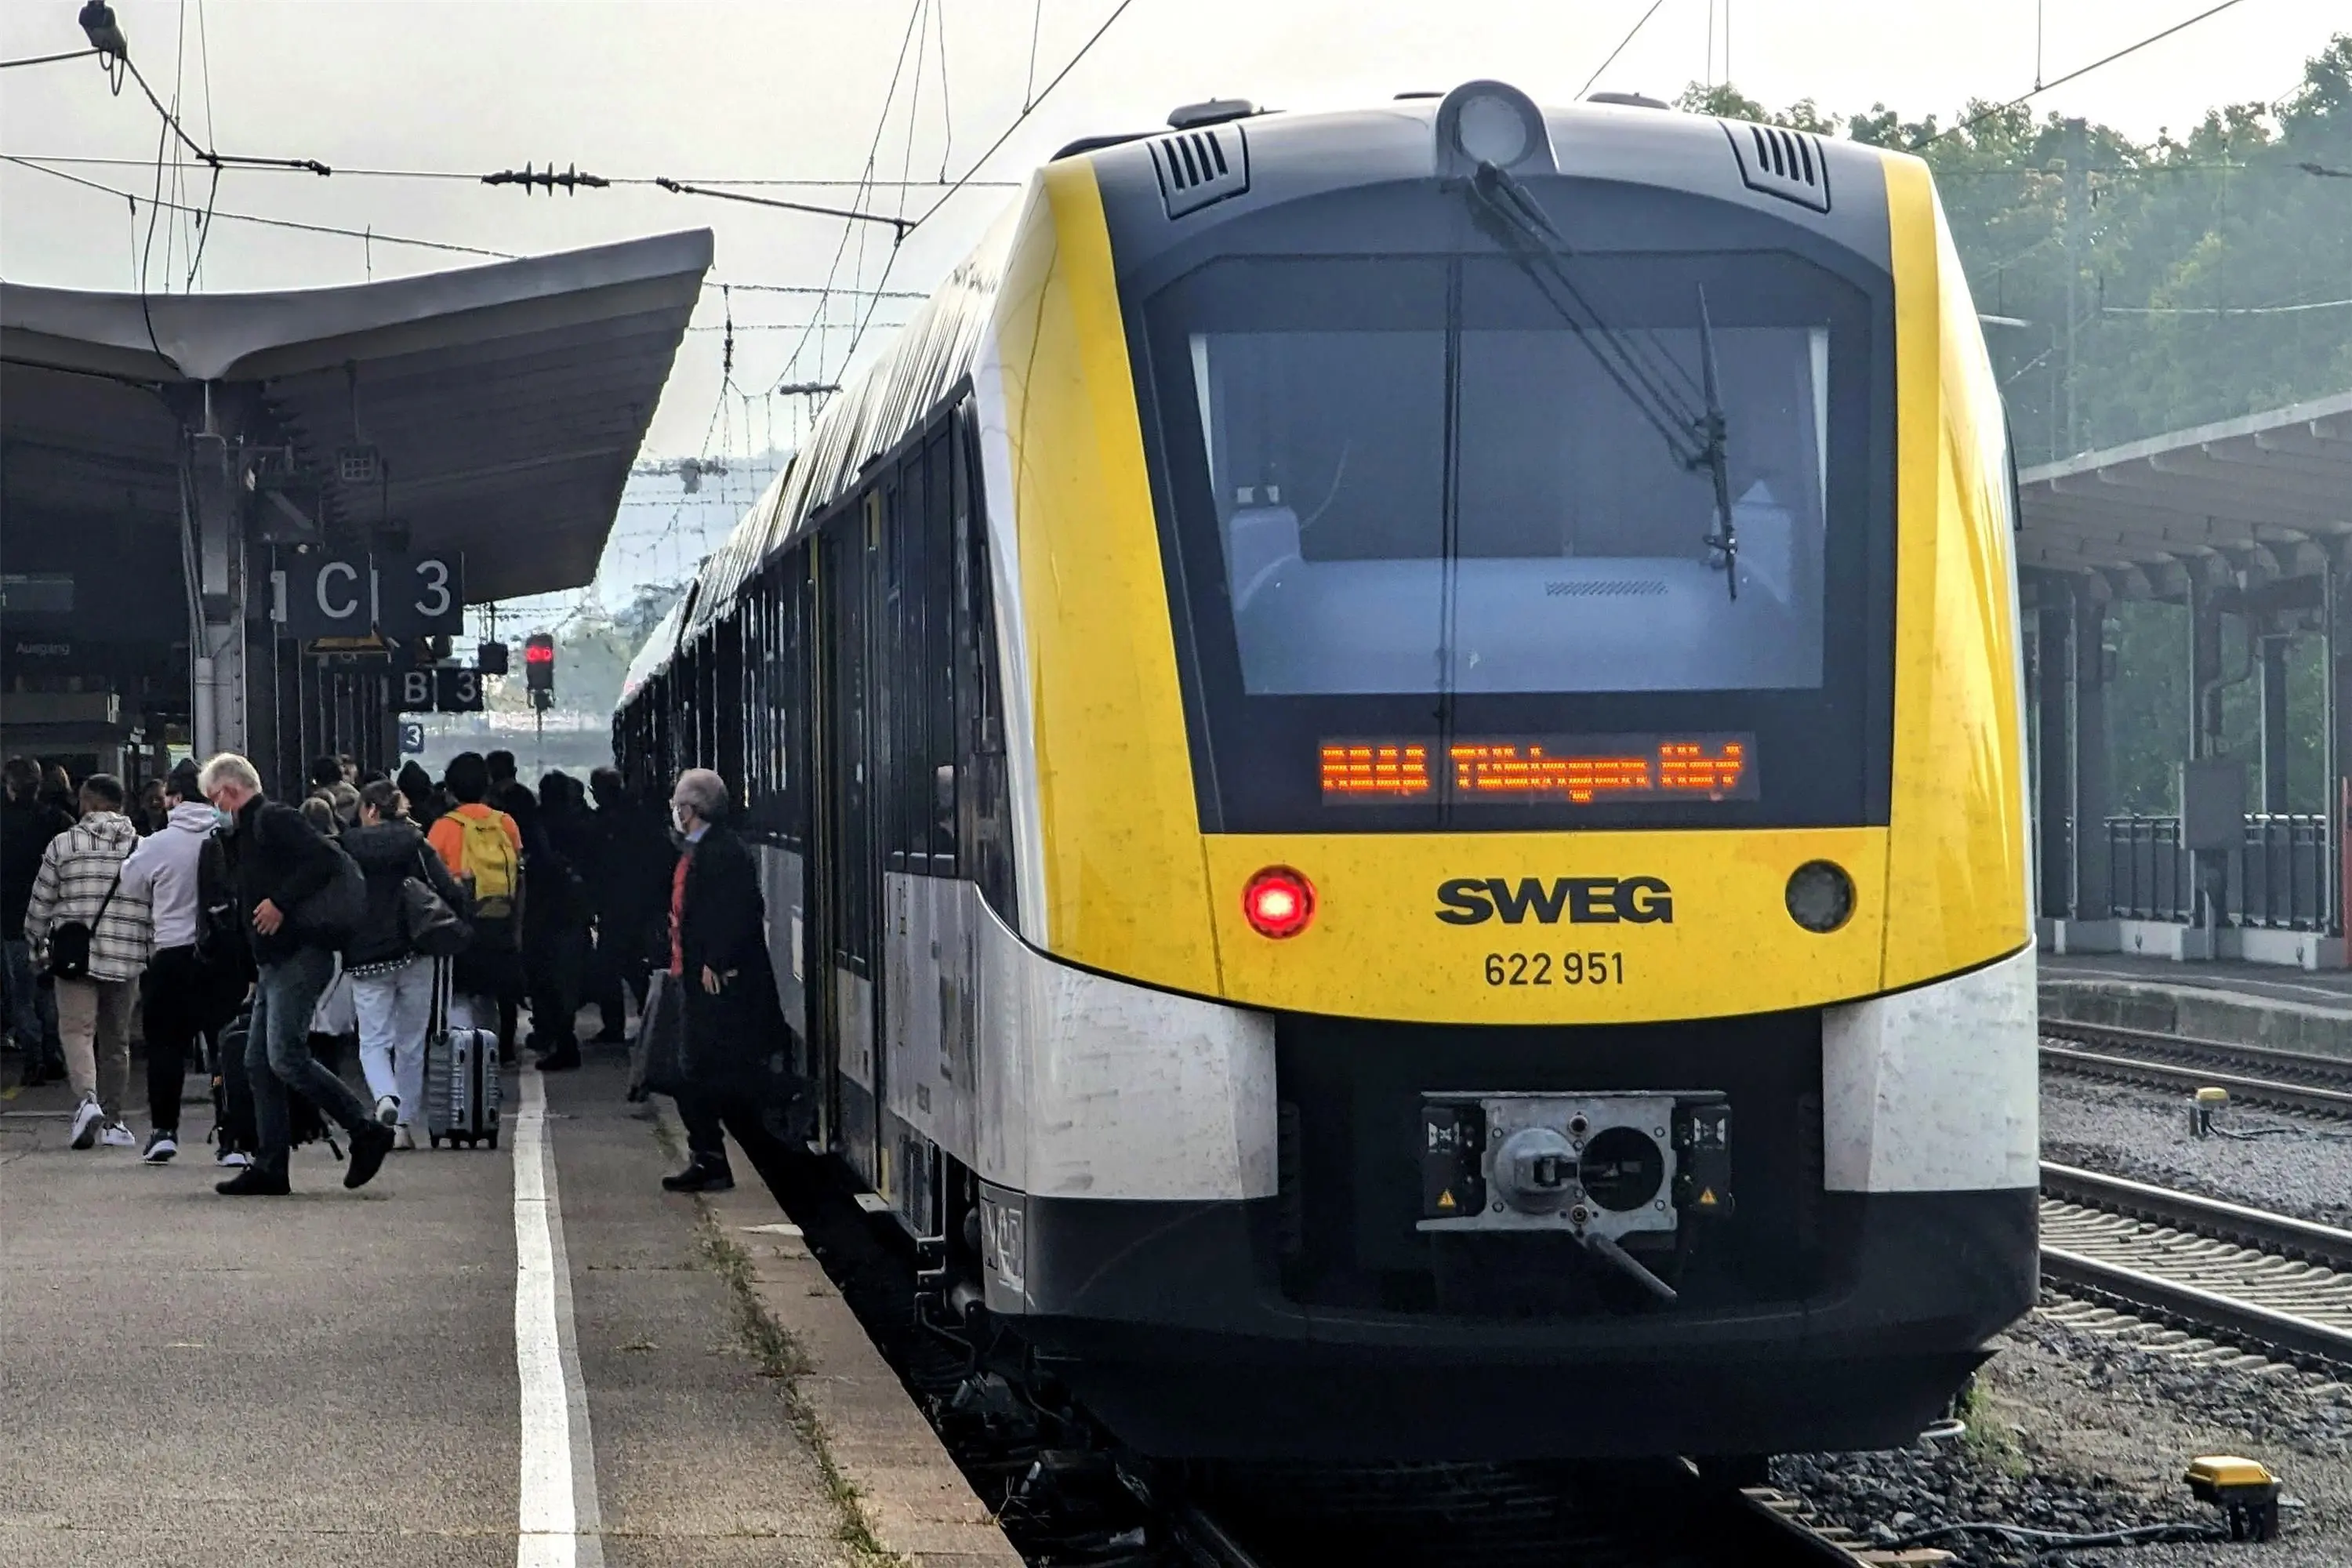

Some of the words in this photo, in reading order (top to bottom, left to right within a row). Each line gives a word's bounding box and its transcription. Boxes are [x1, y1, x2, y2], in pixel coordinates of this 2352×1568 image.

[317, 561, 358, 618] C
[415, 560, 452, 617] 3
[405, 672, 427, 702] B
[456, 671, 477, 702] 3
[405, 725, 421, 746] 3
[1436, 876, 1674, 925] SWEG
[1485, 953, 1552, 985] 622
[1563, 952, 1624, 985] 951
